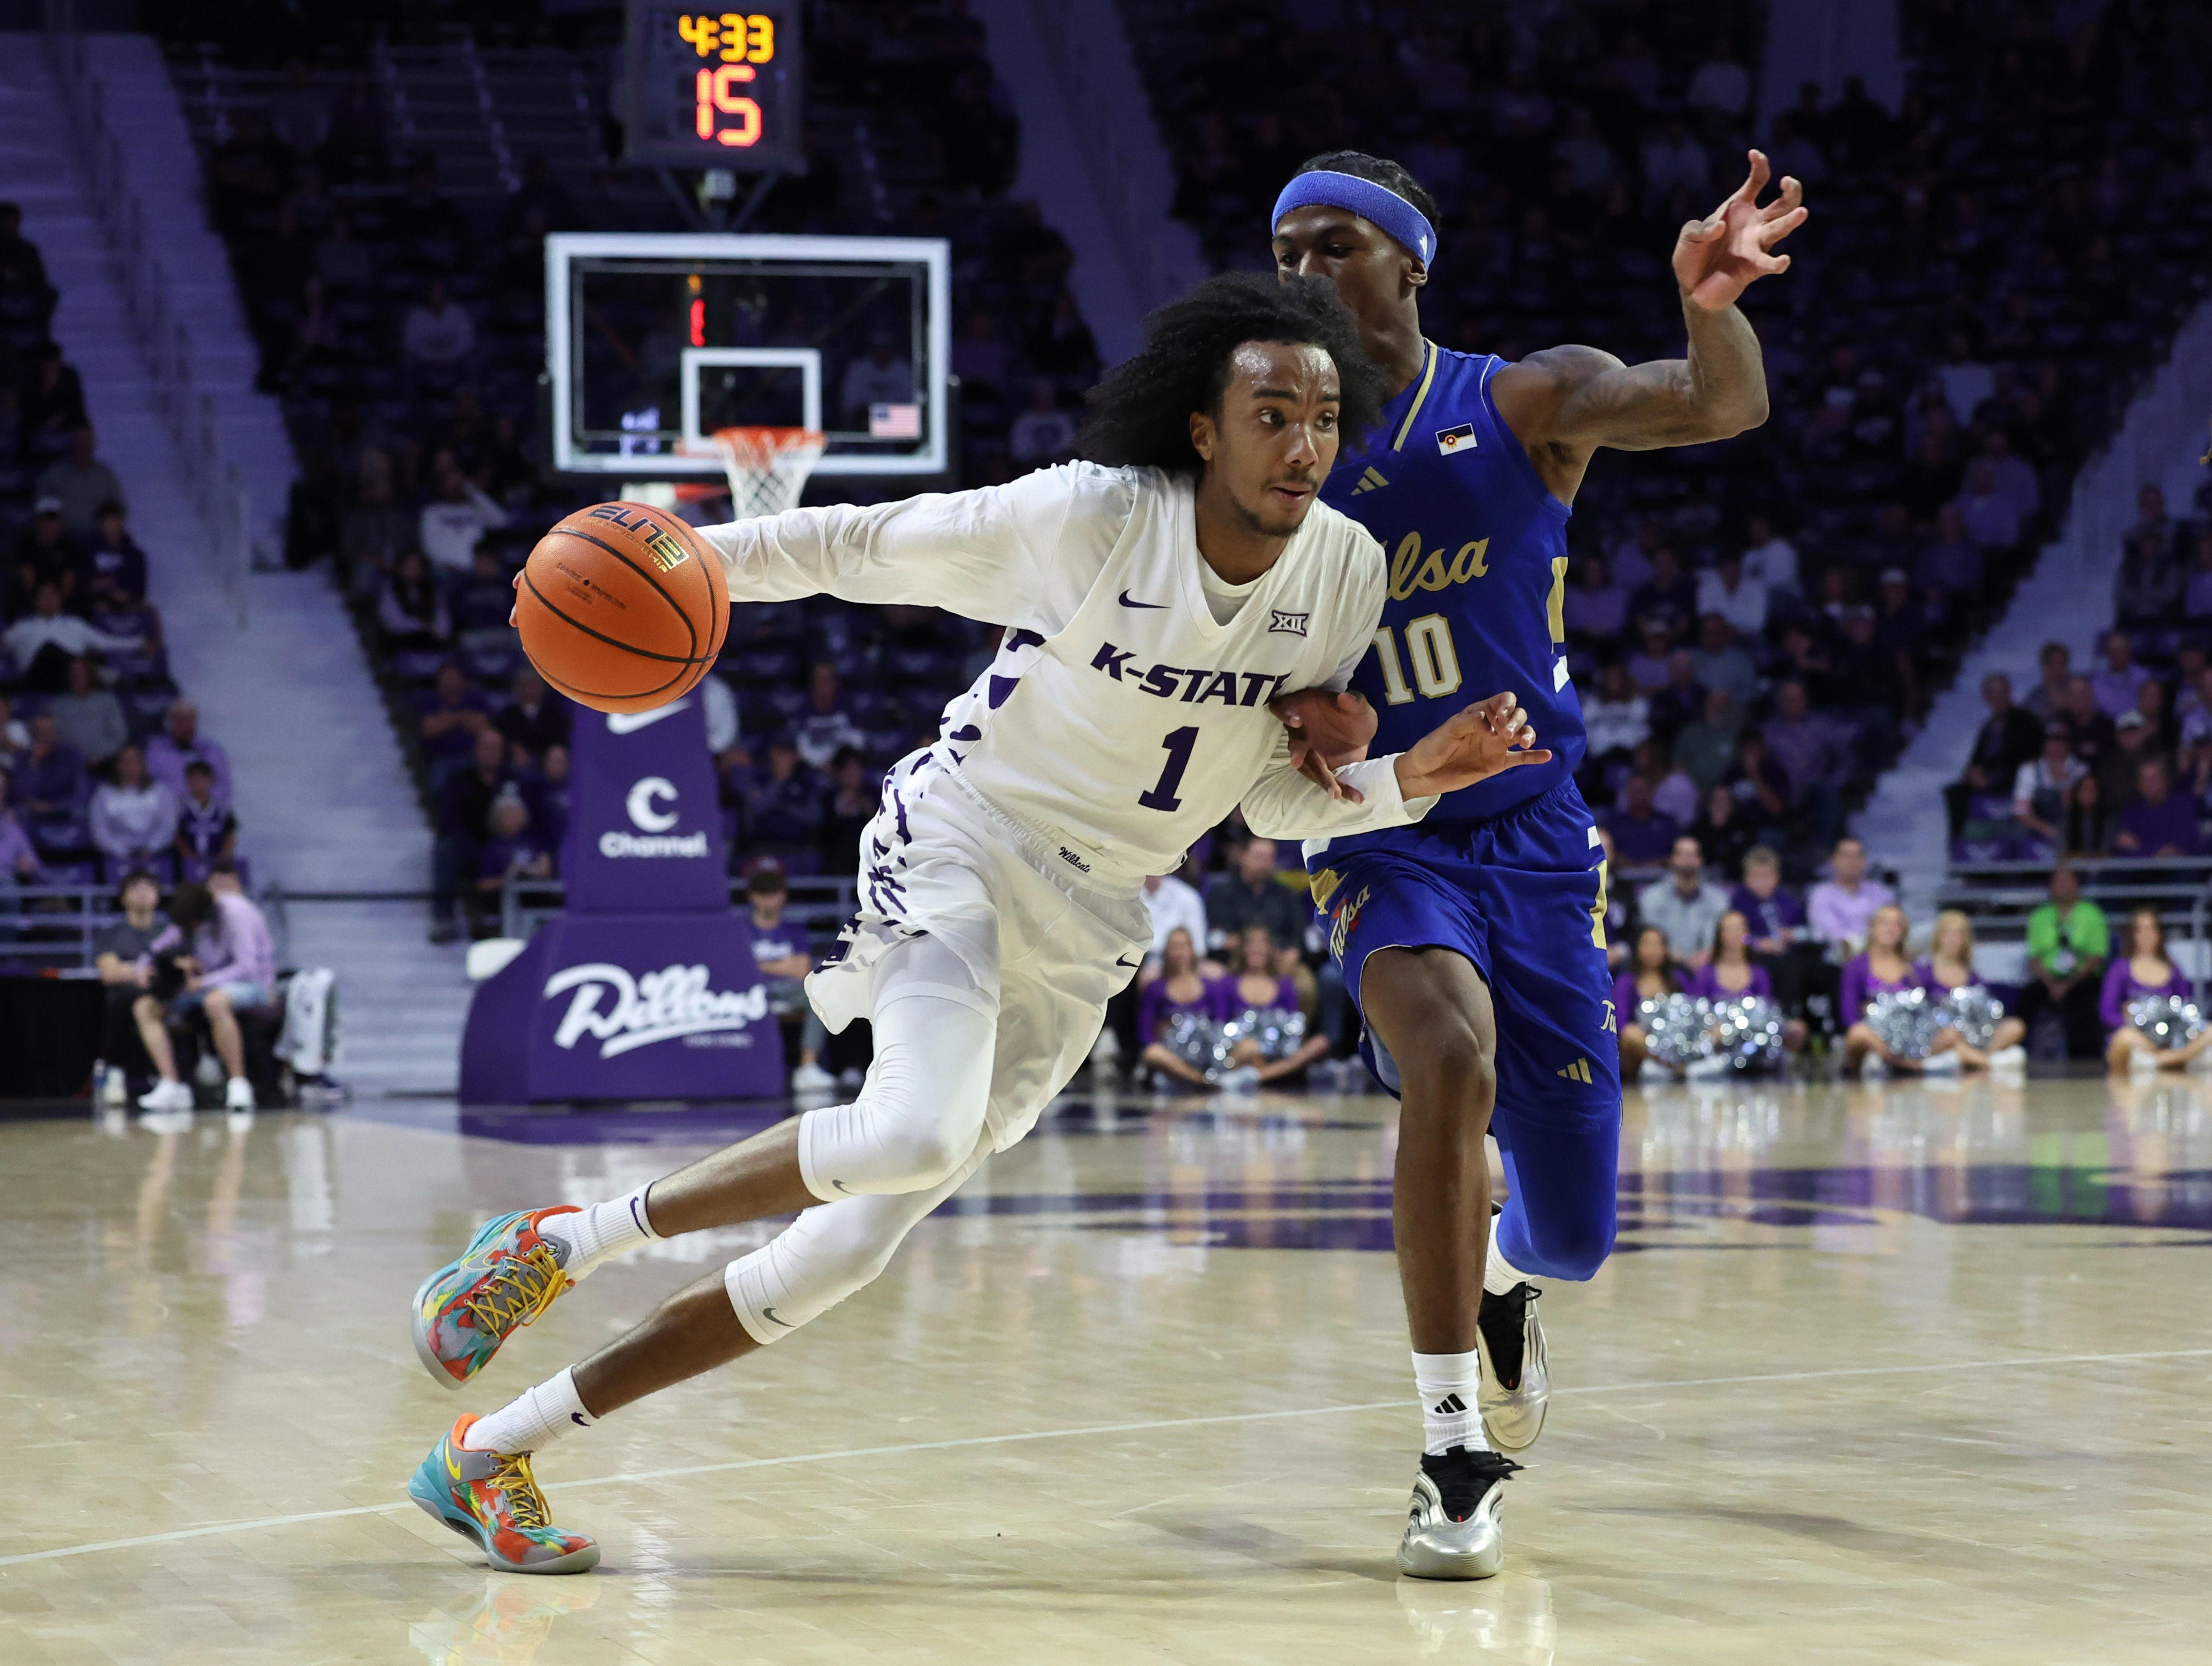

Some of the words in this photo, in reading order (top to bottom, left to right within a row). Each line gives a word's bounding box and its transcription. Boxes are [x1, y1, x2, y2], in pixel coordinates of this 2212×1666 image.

[679, 13, 774, 64] 4:33
[697, 64, 762, 146] 15
[588, 505, 690, 570] ELITE
[1382, 531, 1489, 601] lsa
[1371, 613, 1462, 706] 10
[1138, 726, 1200, 812] 1
[1058, 846, 1091, 873] Wildcats
[1329, 884, 1371, 971] Tulsa
[542, 962, 768, 1052] Dillons
